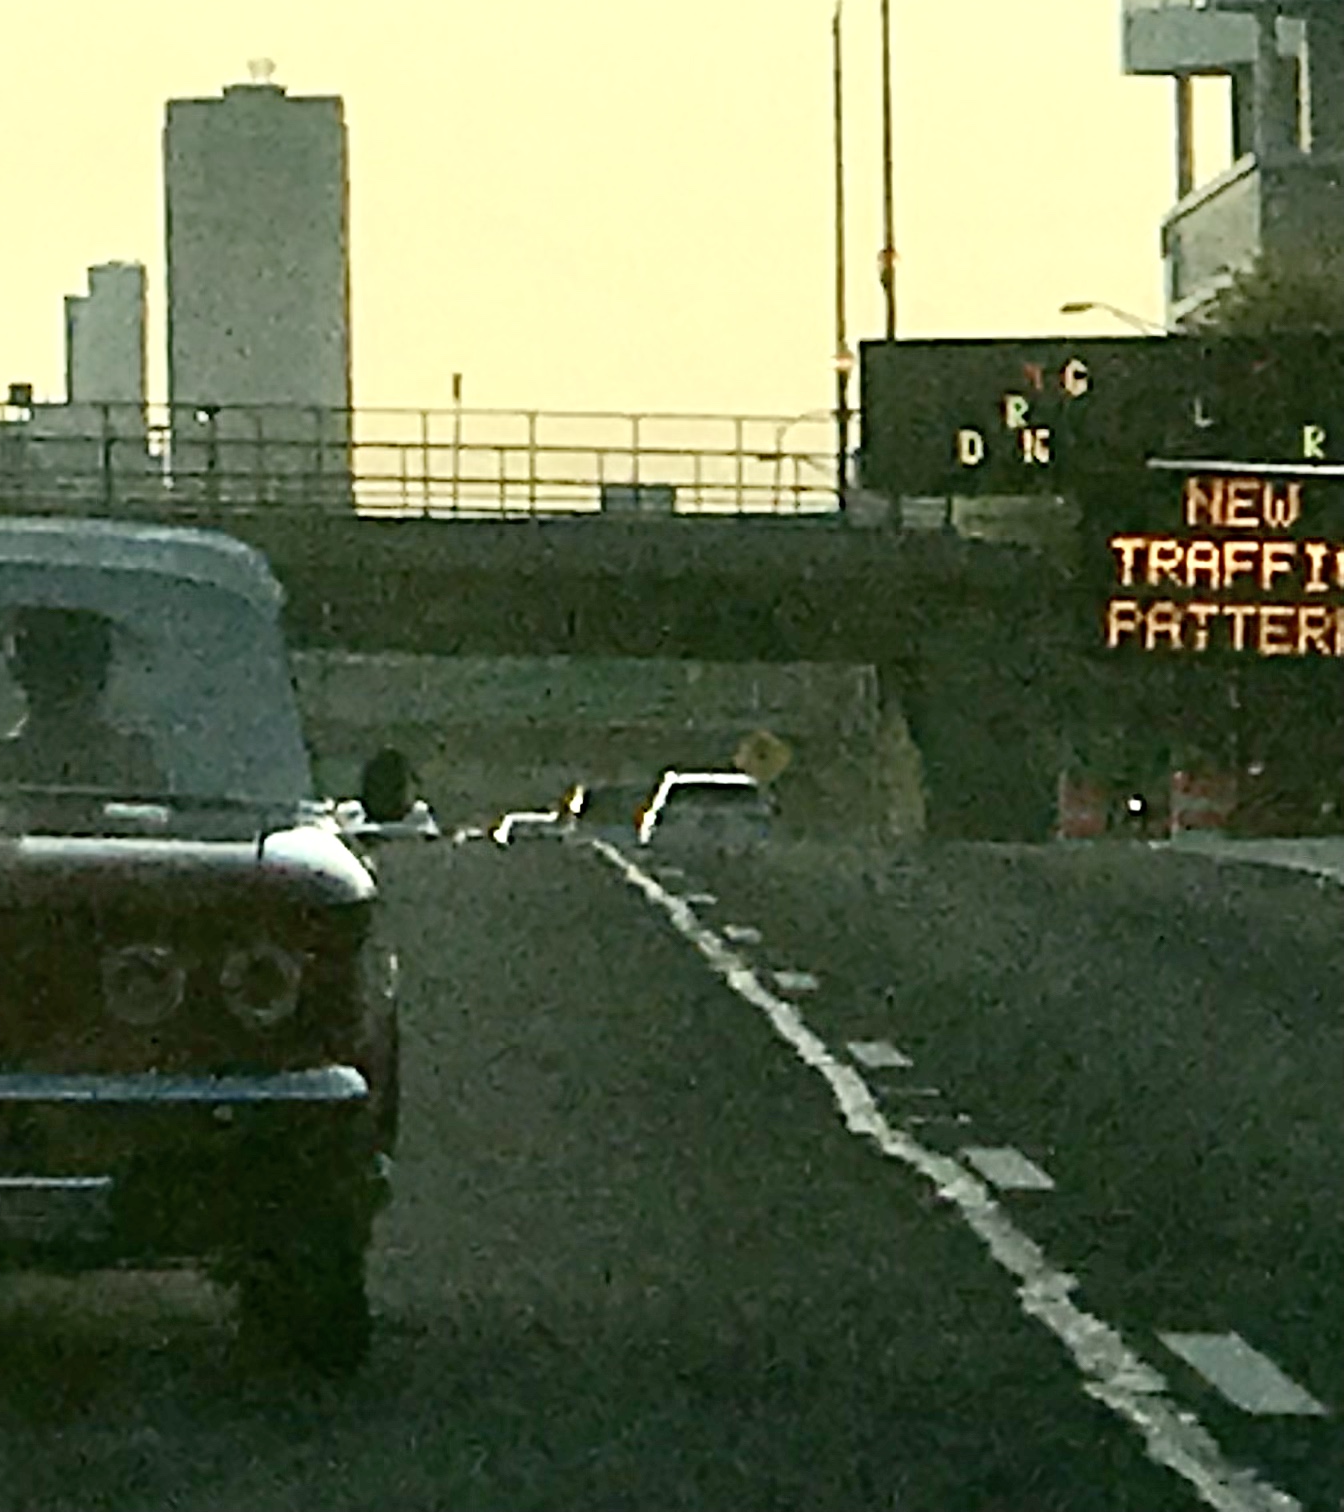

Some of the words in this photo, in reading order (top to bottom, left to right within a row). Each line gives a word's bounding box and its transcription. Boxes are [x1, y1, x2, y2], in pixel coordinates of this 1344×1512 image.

[1186, 477, 1301, 528] NEW
[1111, 537, 1344, 592] TRAFFI
[1108, 600, 1344, 656] PATTER
